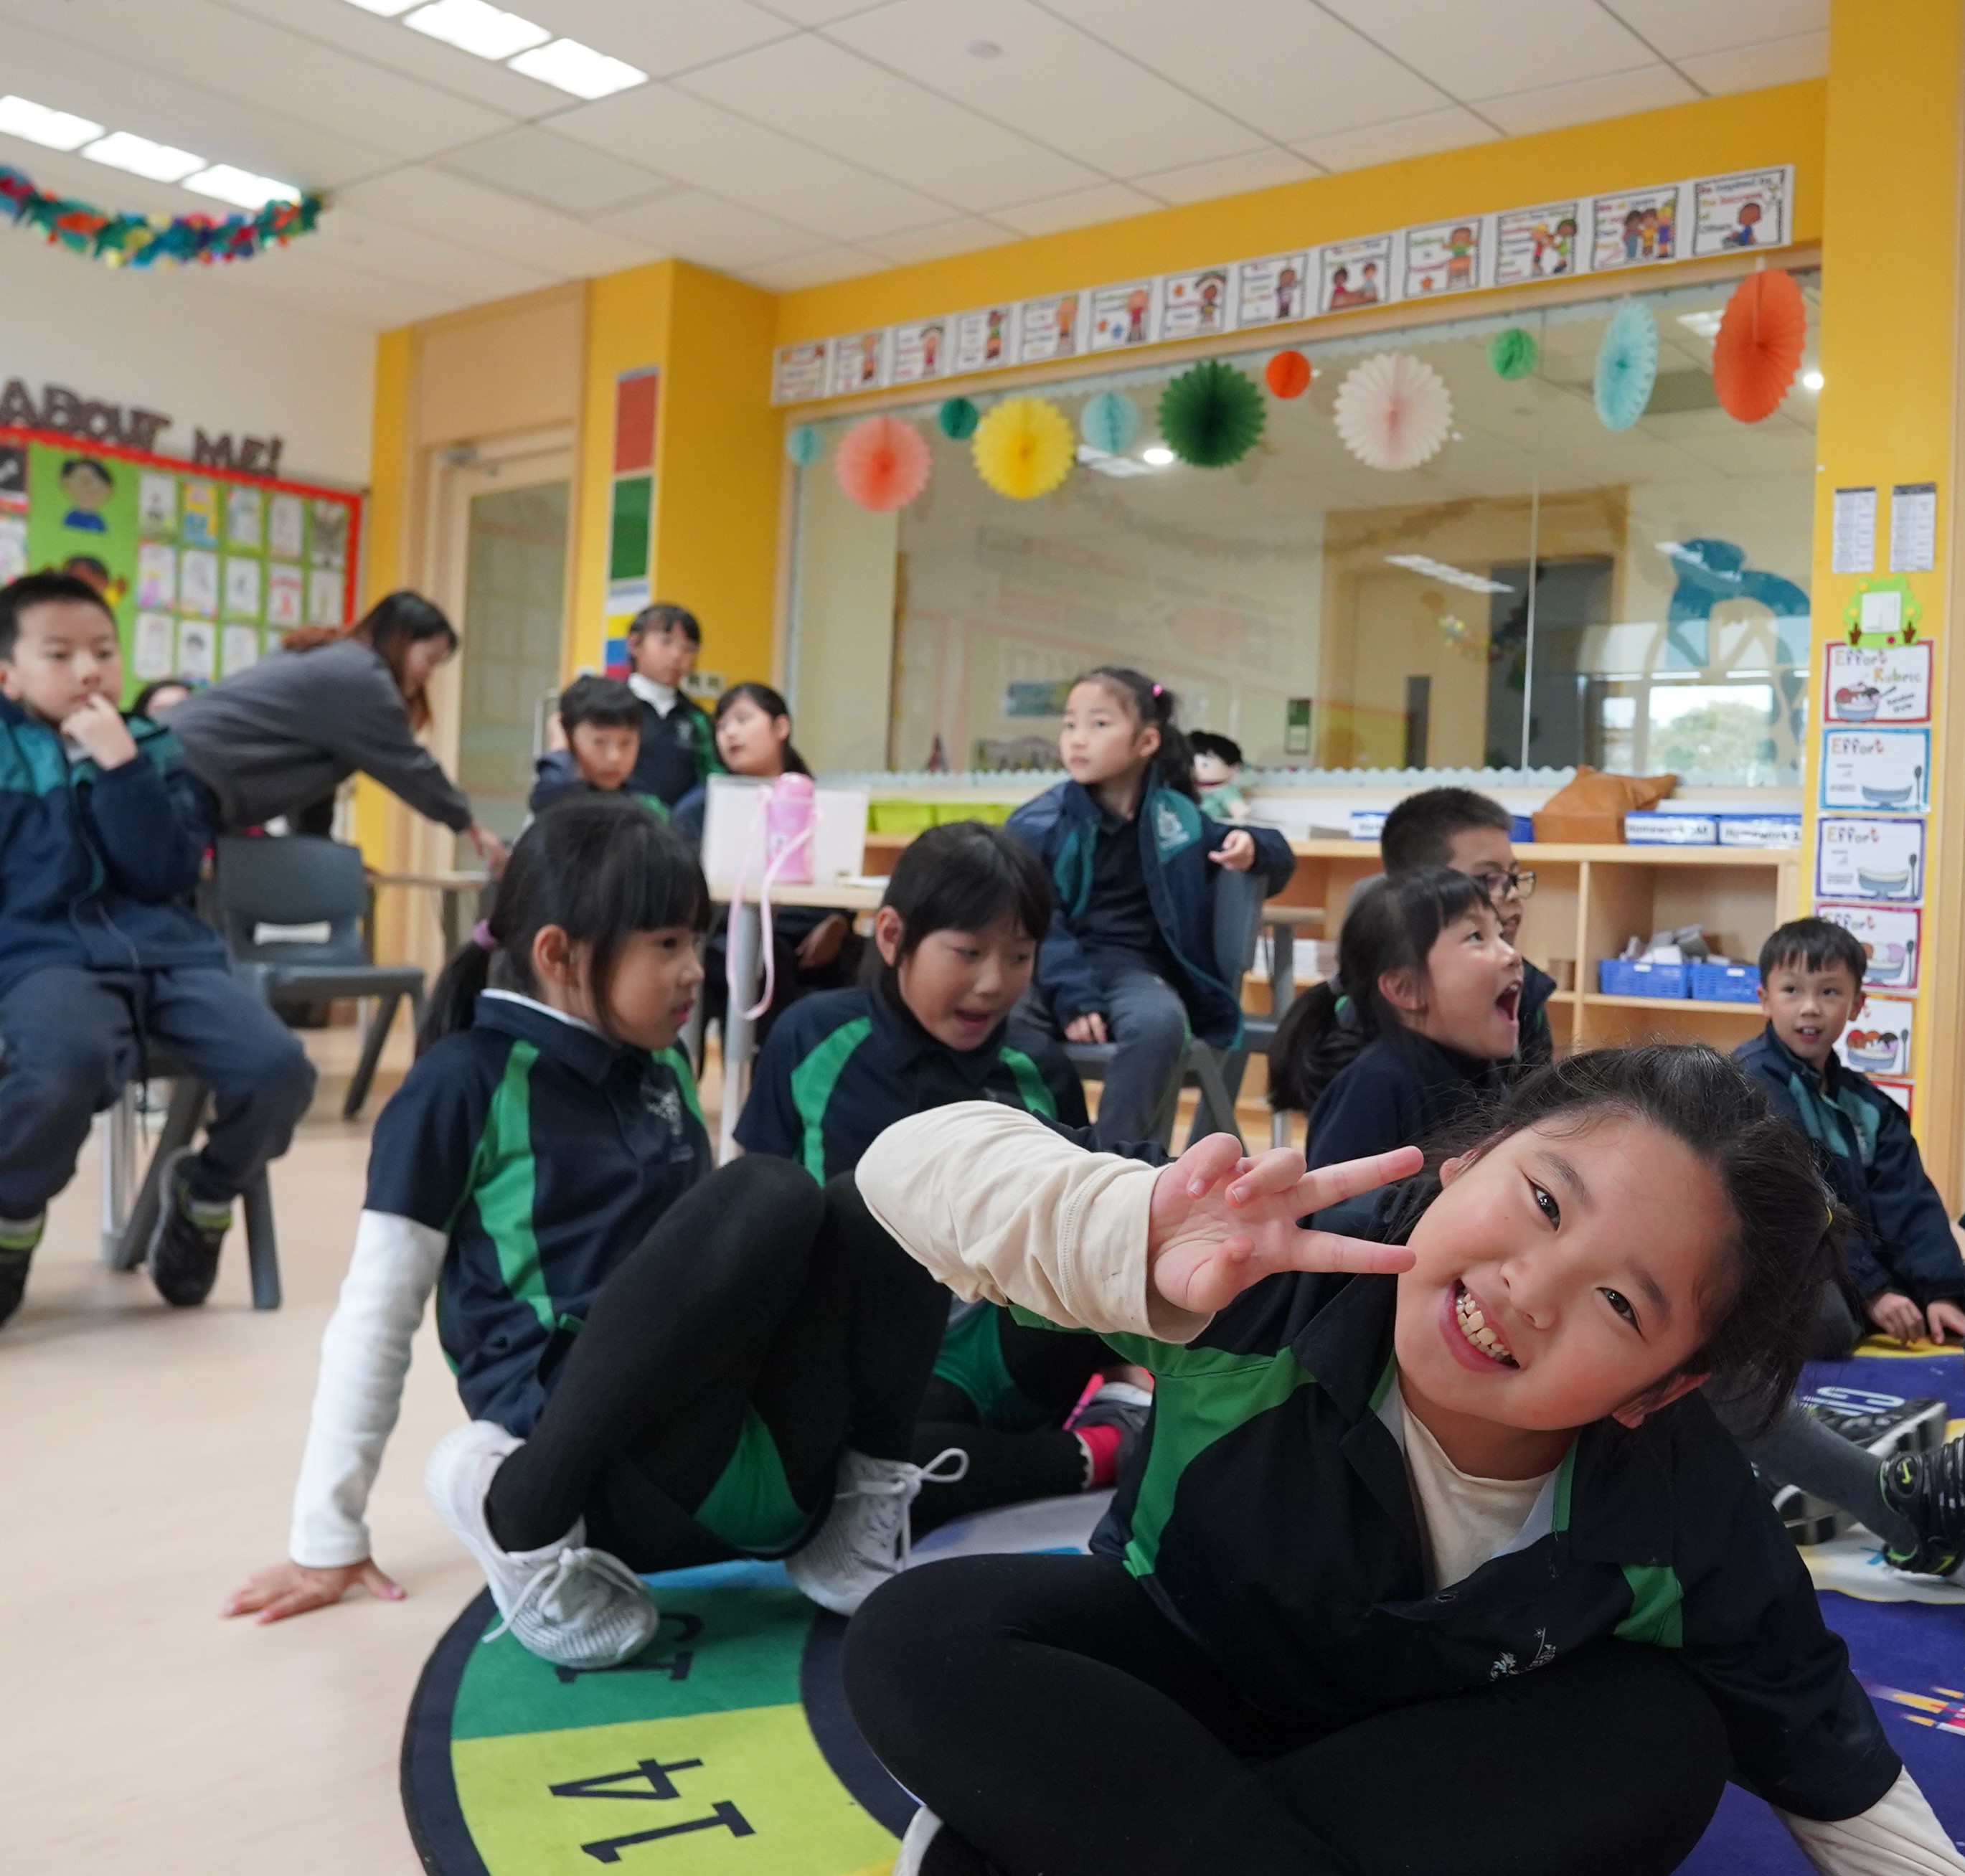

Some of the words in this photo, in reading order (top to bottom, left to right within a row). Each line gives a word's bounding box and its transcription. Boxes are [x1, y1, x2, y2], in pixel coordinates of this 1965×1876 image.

[0, 378, 173, 452] ABOUT
[194, 426, 283, 479] ME!
[1834, 648, 1887, 666] Effort
[1874, 667, 1922, 682] Rubric
[1832, 737, 1884, 754] Effort
[1827, 826, 1879, 843] Effort
[1824, 913, 1875, 930] ffort
[548, 1758, 756, 1863] 14
